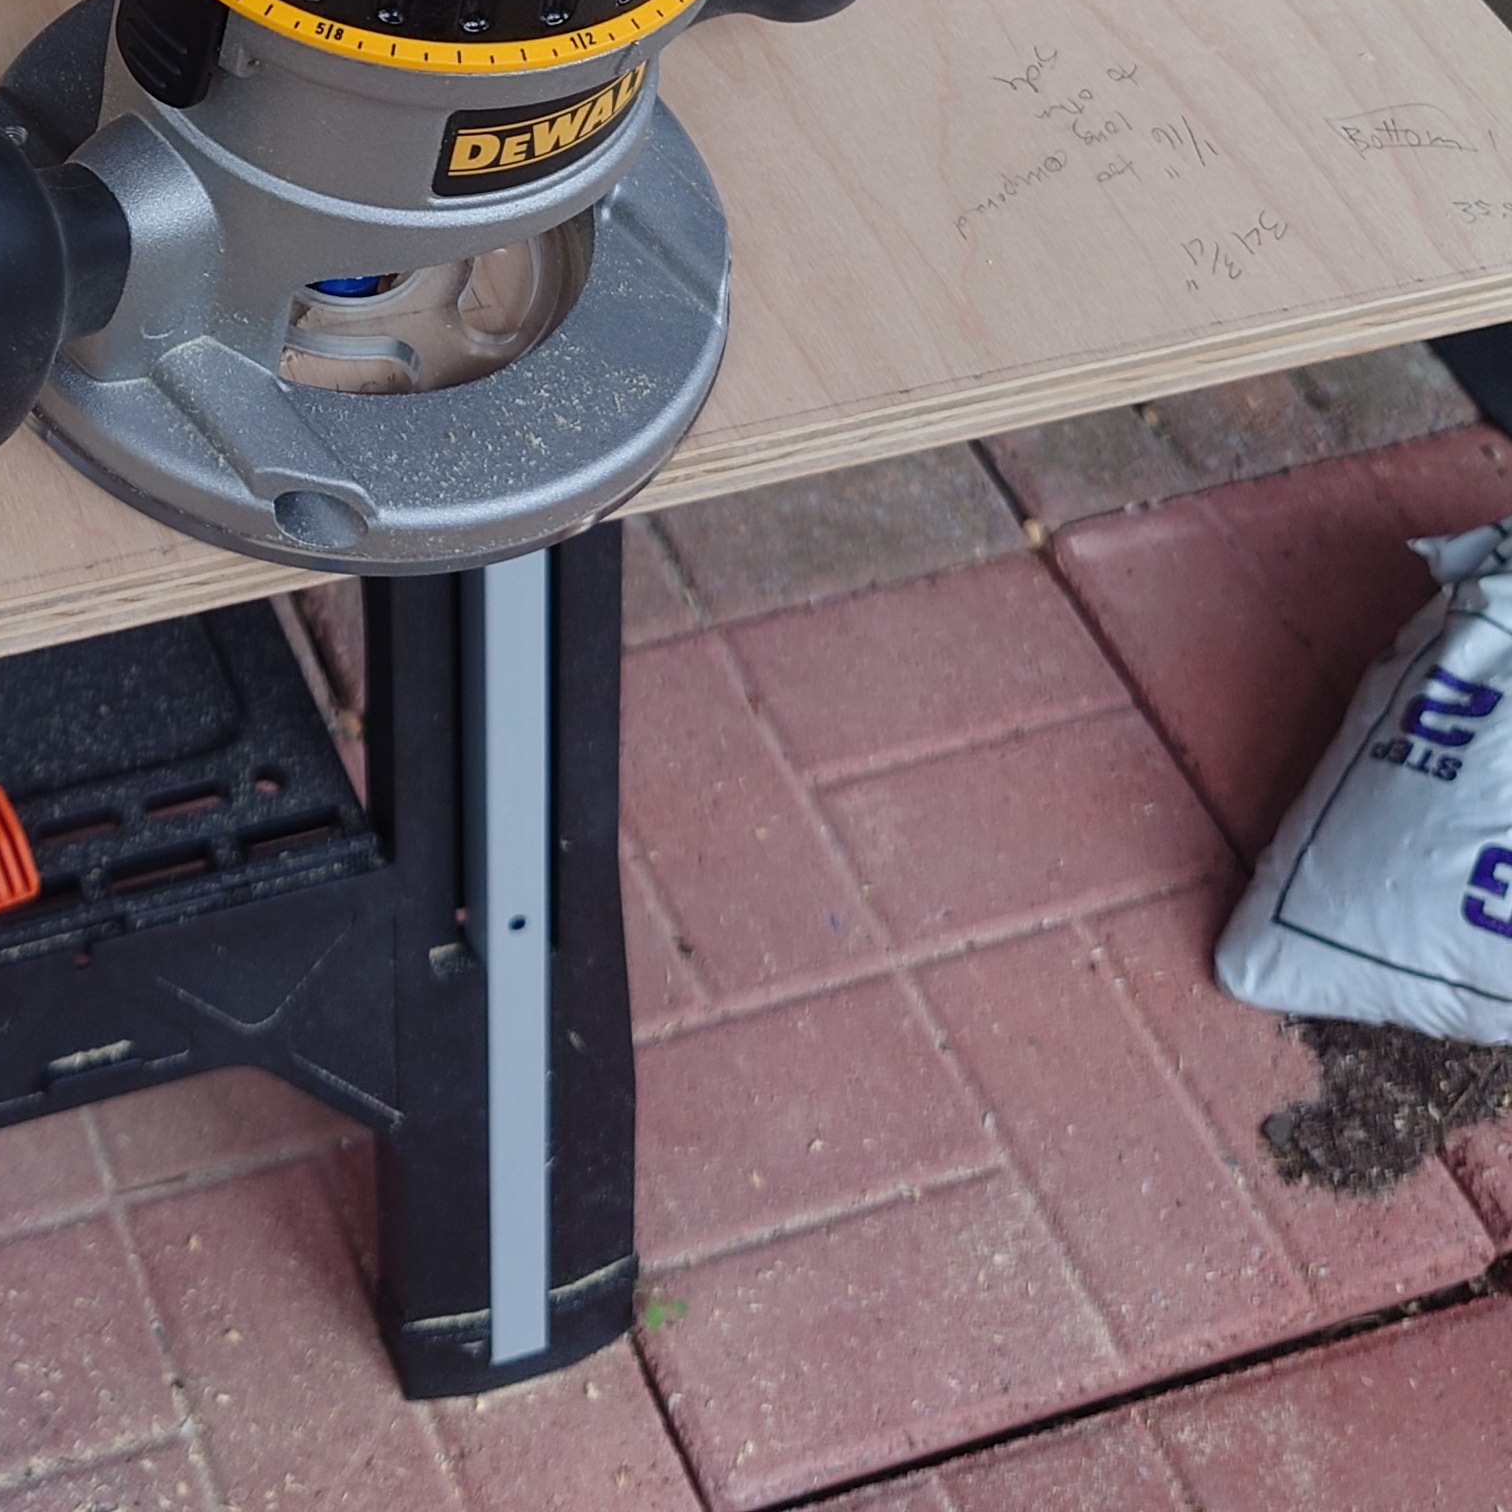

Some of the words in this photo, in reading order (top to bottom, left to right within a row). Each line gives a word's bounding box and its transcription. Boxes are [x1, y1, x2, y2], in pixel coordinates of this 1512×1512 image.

[314, 23, 344, 41] 5/8
[569, 32, 597, 49] 1/2
[1402, 664, 1504, 747] 2
[1369, 737, 1463, 782] STEP
